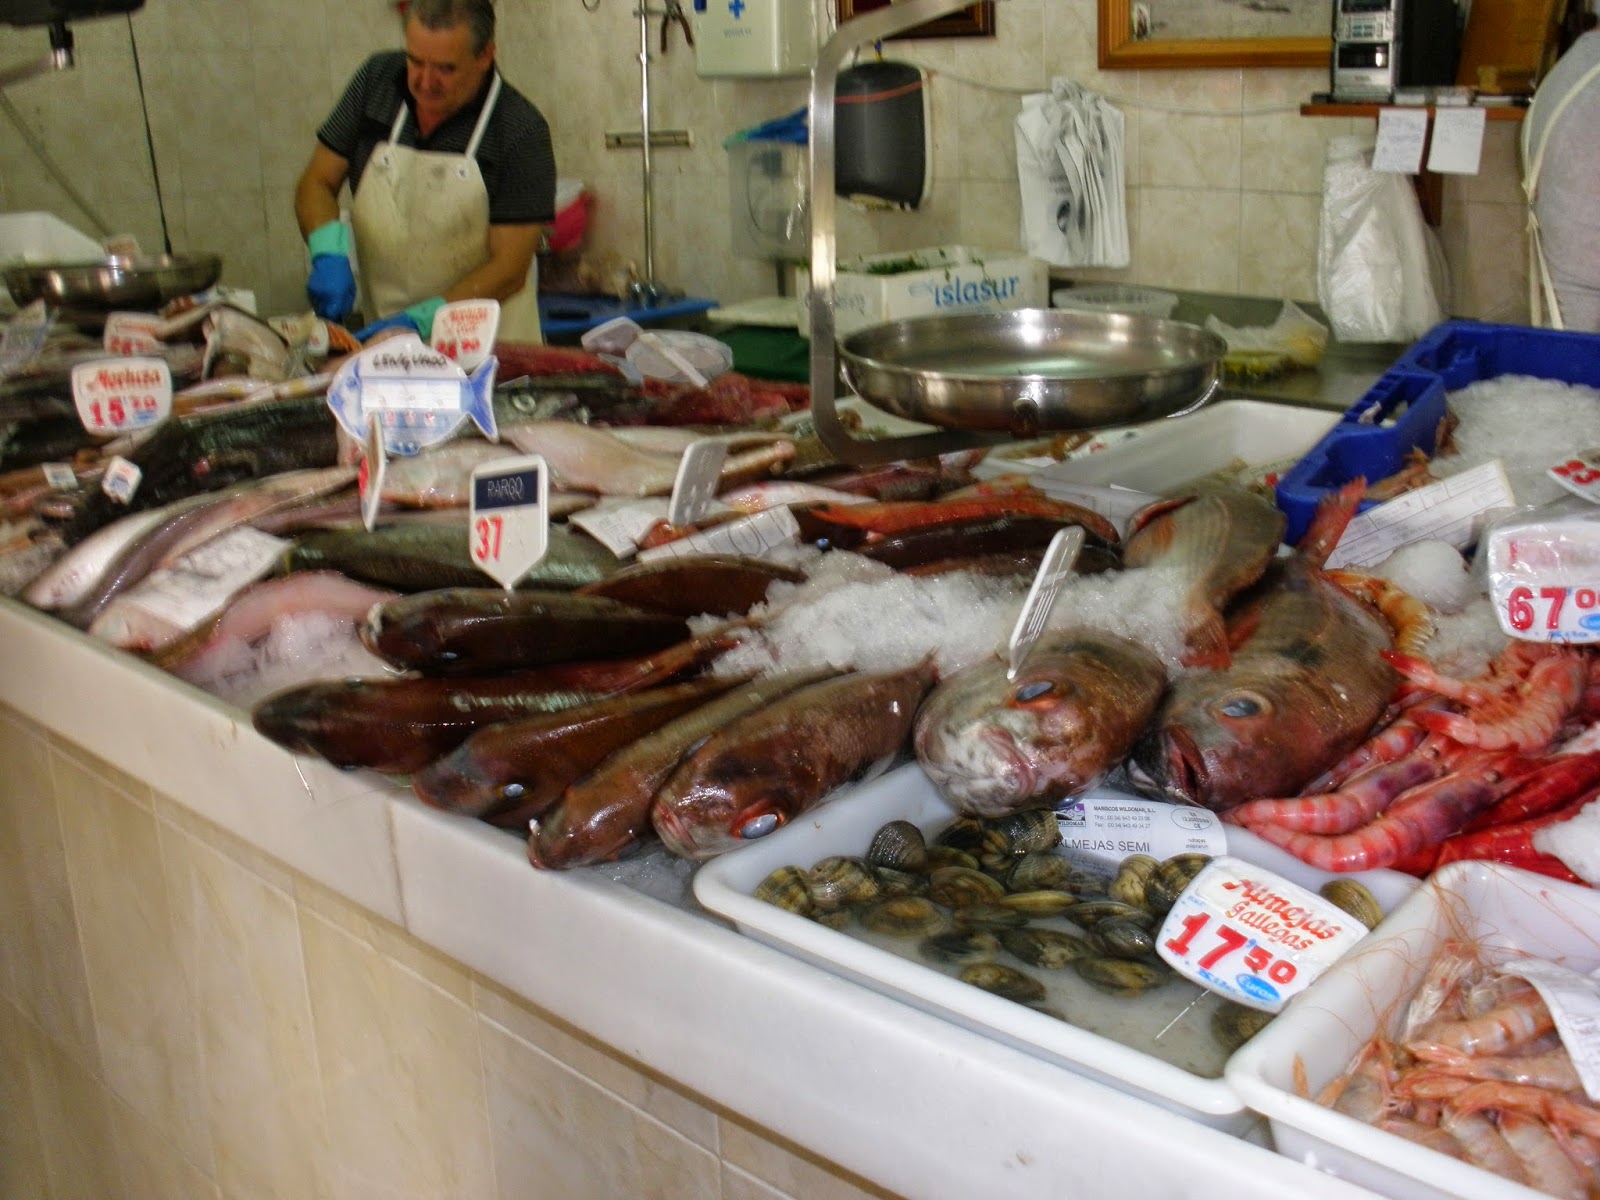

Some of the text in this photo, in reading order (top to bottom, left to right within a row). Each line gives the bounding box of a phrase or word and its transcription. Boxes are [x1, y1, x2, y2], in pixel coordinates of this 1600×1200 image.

[934, 275, 1019, 307] islasur
[487, 477, 525, 500] PARGO
[475, 515, 503, 561] 37
[1118, 841, 1150, 852] SEMI
[1221, 879, 1342, 940] Almejas
